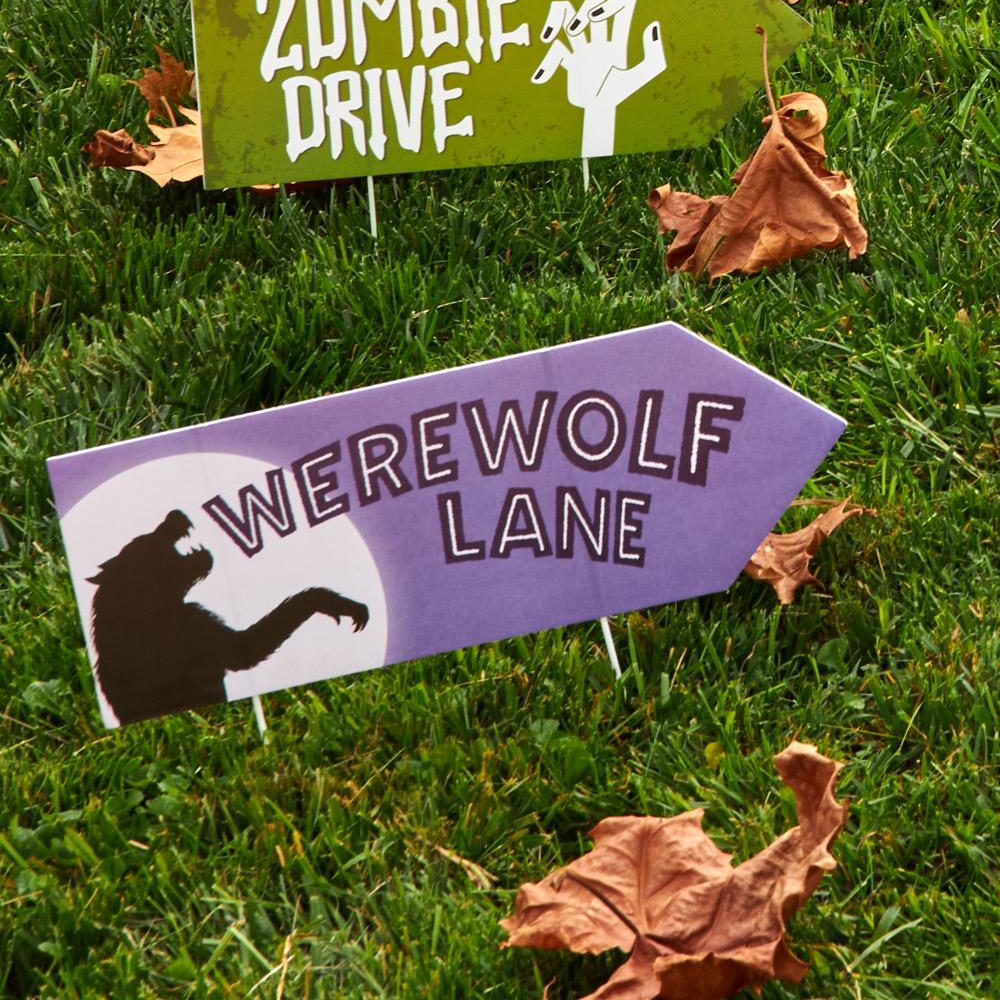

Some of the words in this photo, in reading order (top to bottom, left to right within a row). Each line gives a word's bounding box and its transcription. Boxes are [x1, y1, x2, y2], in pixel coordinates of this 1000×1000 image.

[281, 60, 473, 162] DRIVE
[202, 389, 746, 558] WEREWOLF
[437, 486, 652, 568] LANE
